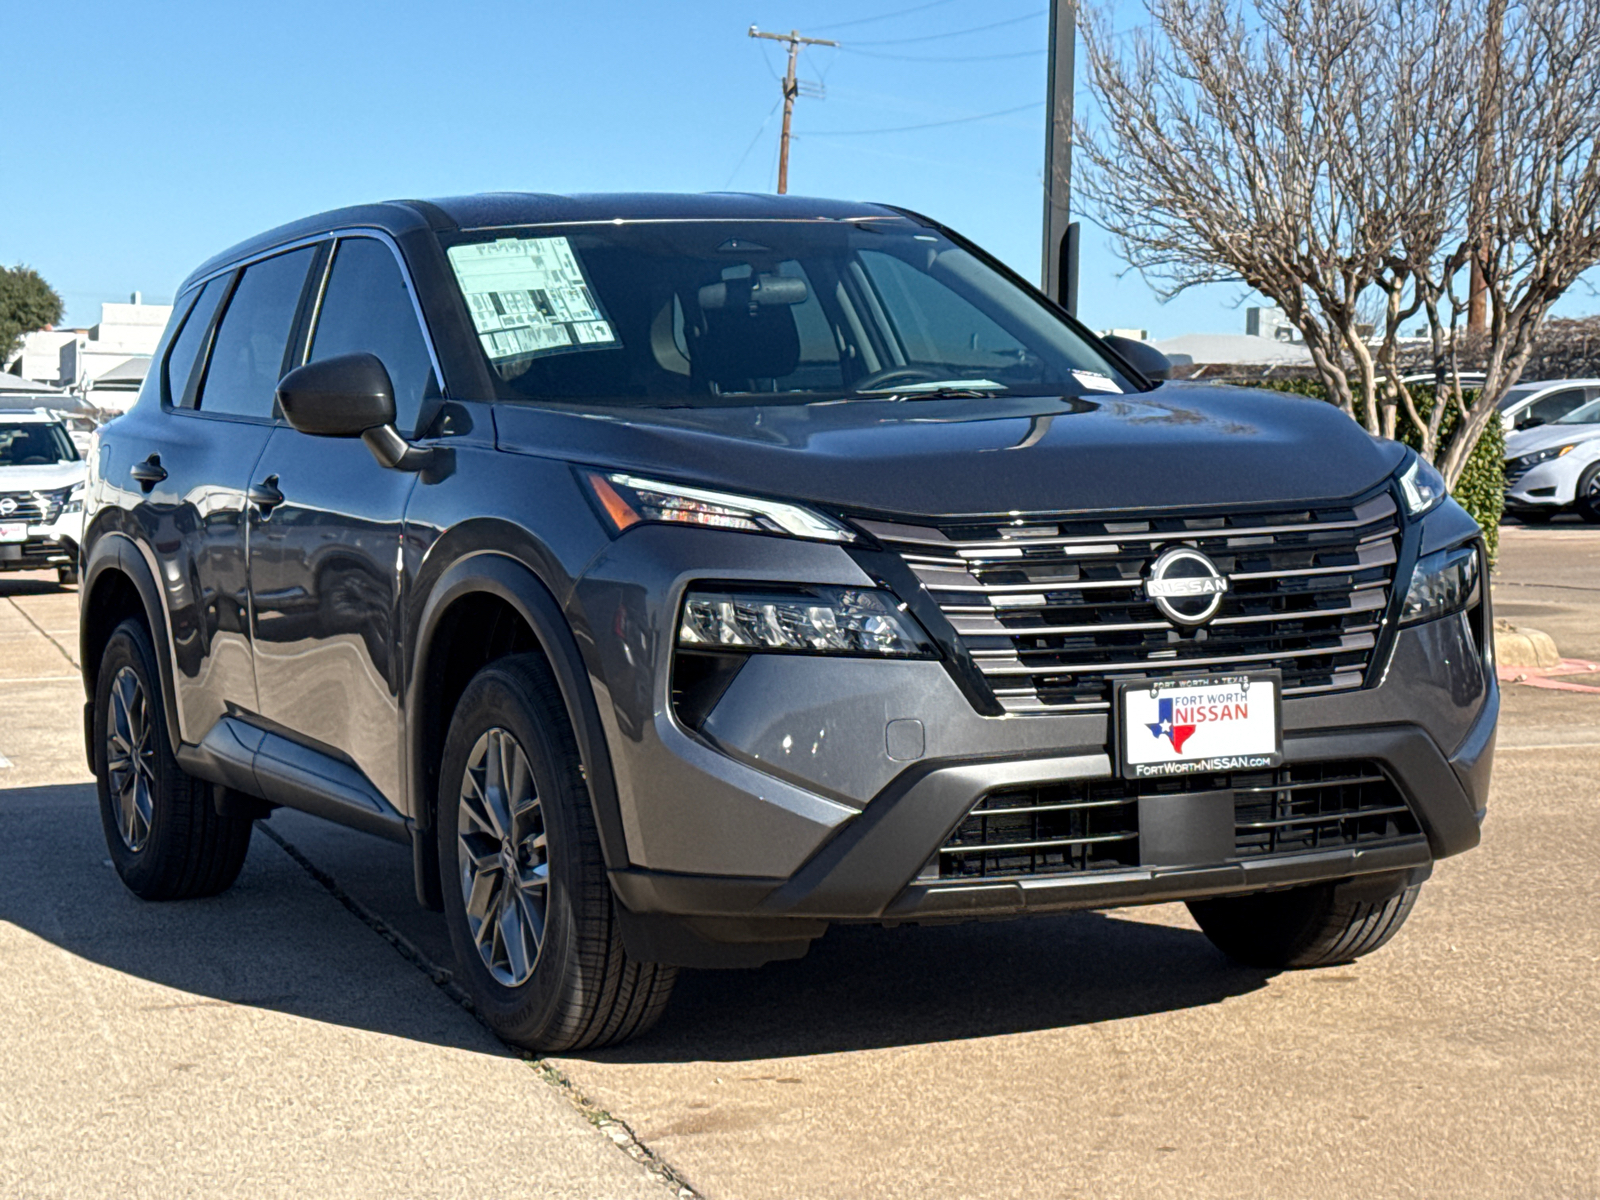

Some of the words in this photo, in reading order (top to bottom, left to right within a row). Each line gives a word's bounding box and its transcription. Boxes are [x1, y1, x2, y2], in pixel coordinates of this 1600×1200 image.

[1150, 578, 1228, 595] NISSAN
[1153, 681, 1176, 690] FORT
[1179, 679, 1209, 688] WORTH
[1221, 676, 1249, 684] TEXAS
[1175, 694, 1204, 706] FORT
[1207, 692, 1248, 704] WORTH
[1175, 703, 1248, 724] NISSAN
